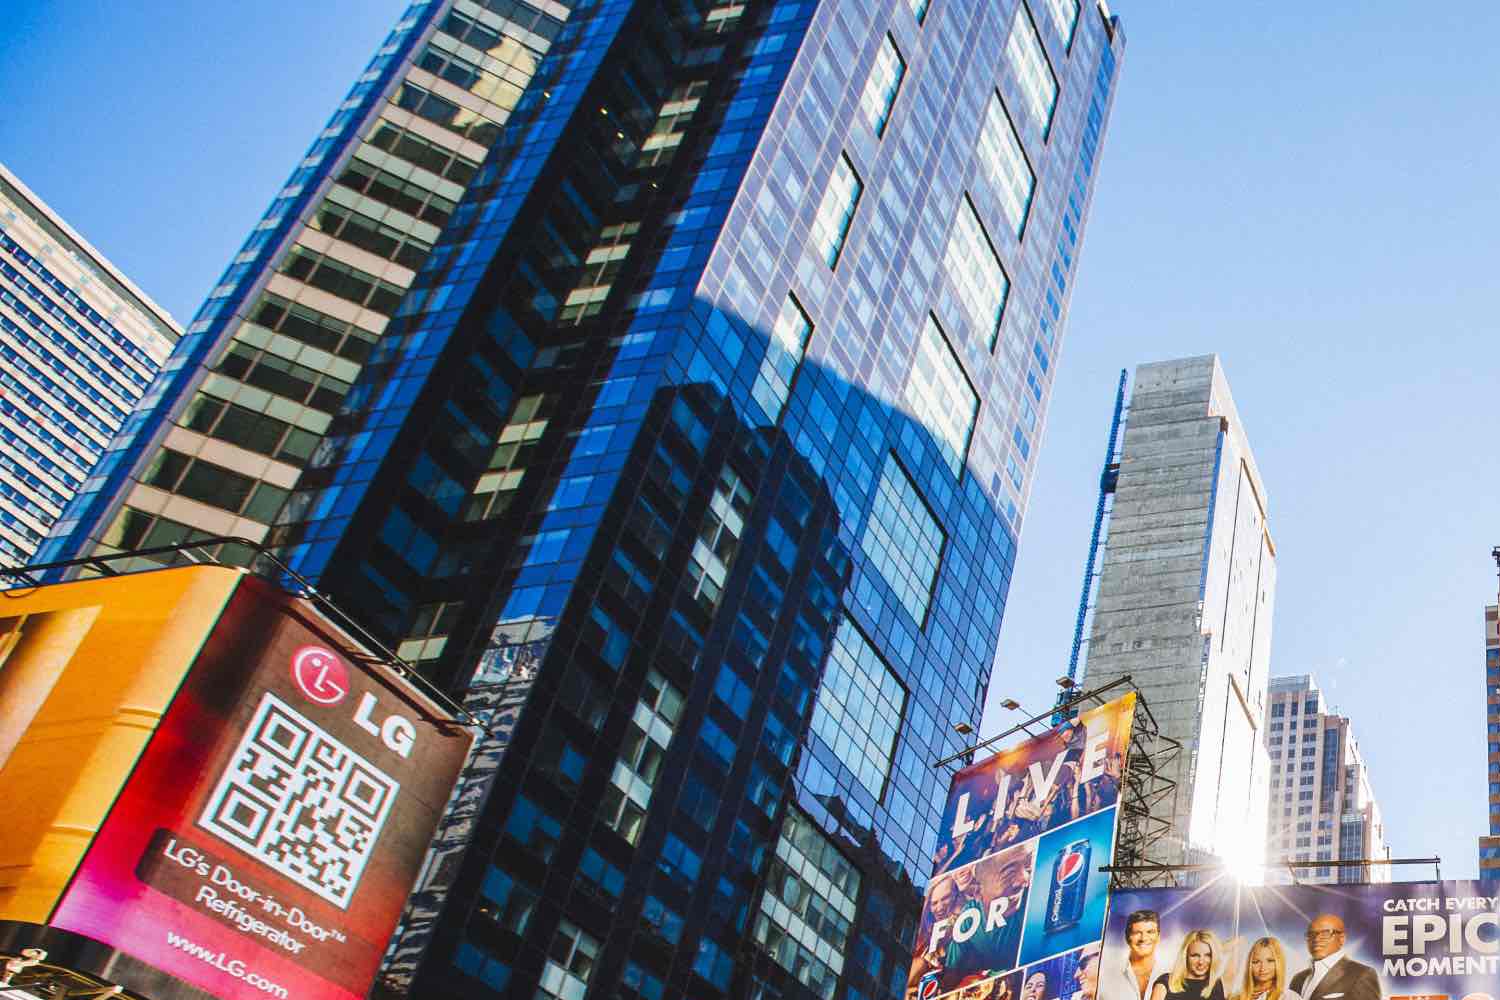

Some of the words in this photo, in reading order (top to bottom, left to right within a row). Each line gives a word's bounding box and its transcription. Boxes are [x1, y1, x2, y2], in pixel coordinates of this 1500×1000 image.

[352, 691, 417, 758] LG
[951, 729, 1110, 839] LIVE
[164, 839, 210, 877] LG's
[196, 886, 305, 954] Refrigerator
[928, 896, 1010, 955] FOR
[1382, 913, 1500, 955] EPIC
[1383, 898, 1440, 912] CATCH
[1445, 897, 1499, 910] EVERY
[167, 931, 288, 999] www.LG.com
